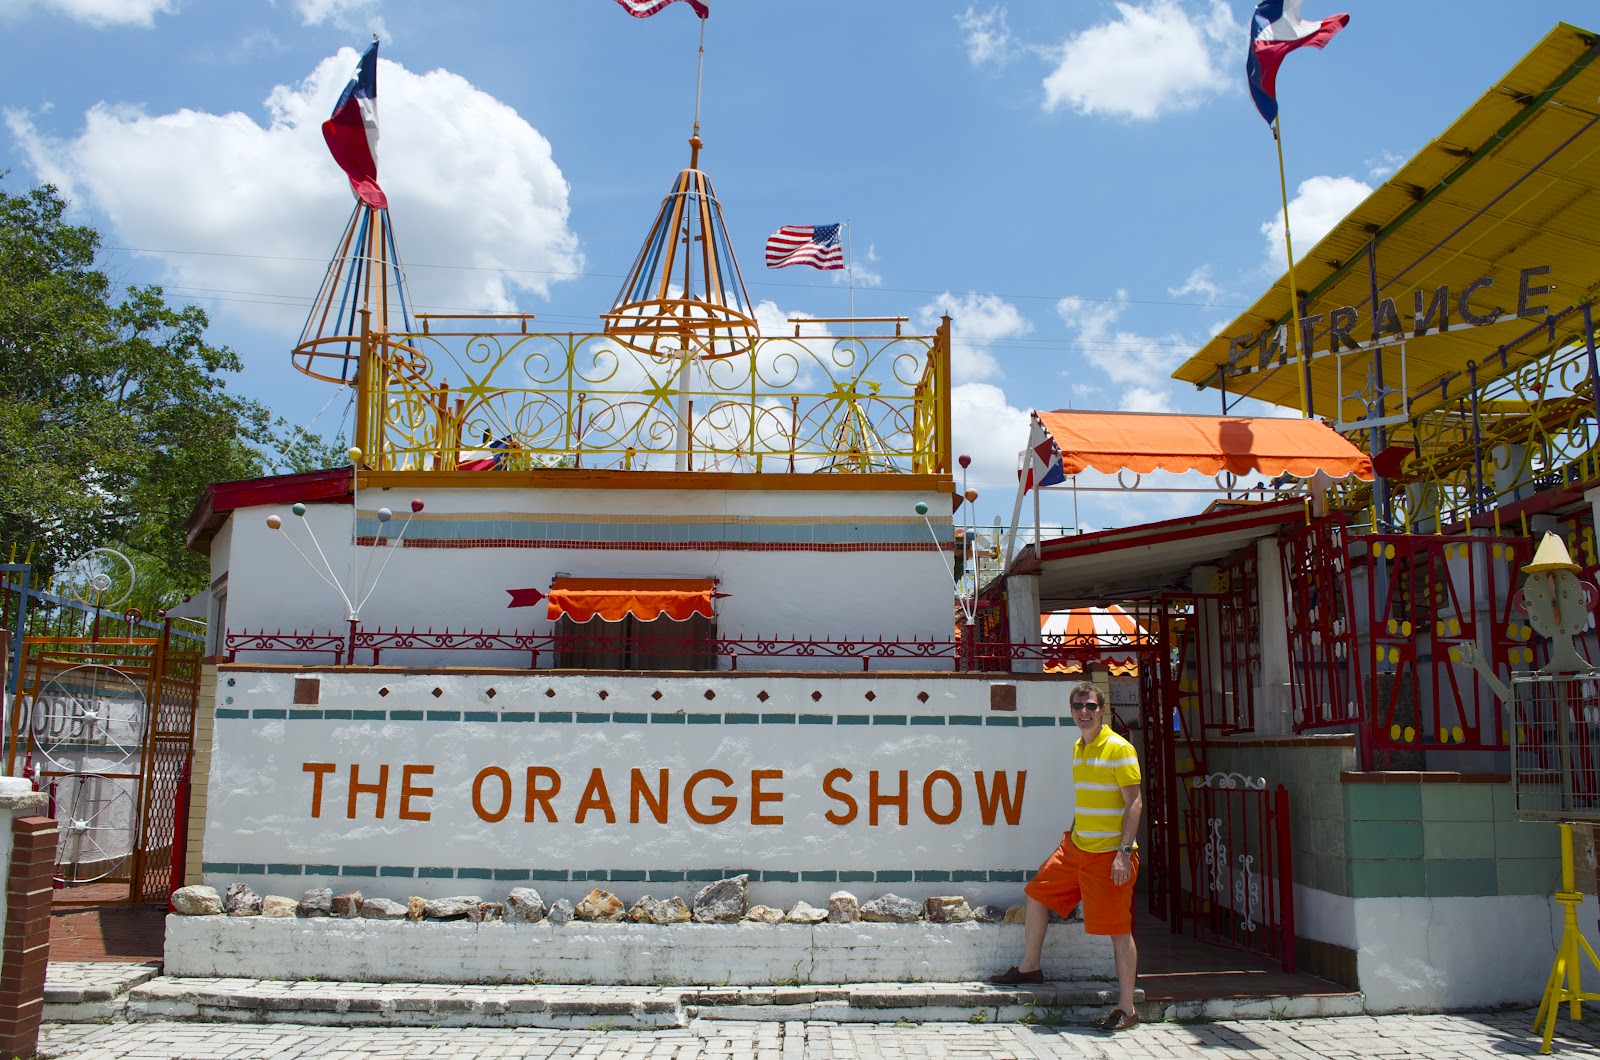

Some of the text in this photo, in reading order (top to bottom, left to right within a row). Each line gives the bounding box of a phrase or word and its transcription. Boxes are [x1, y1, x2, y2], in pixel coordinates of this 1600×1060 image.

[1228, 265, 1552, 377] ENTRANCE
[302, 762, 1026, 827] THE ORANGE SHOW
